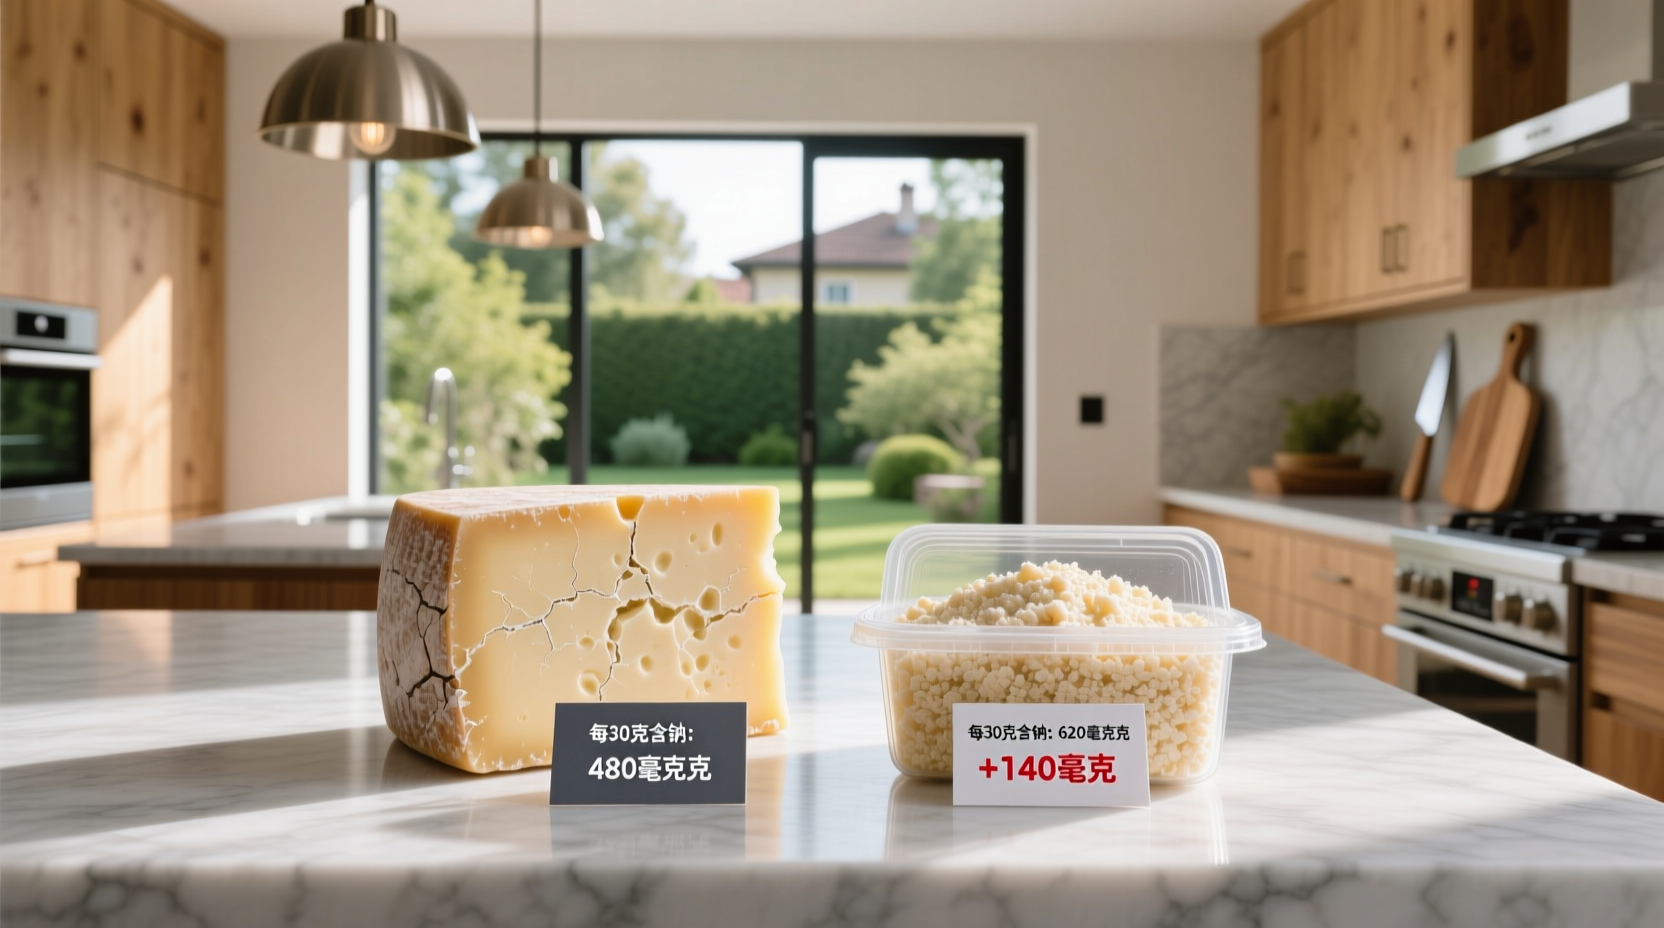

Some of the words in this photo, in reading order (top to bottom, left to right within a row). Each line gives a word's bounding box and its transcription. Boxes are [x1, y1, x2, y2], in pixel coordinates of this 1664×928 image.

[588, 754, 712, 782] 480毫克克
[978, 753, 1117, 784] +140毫克
